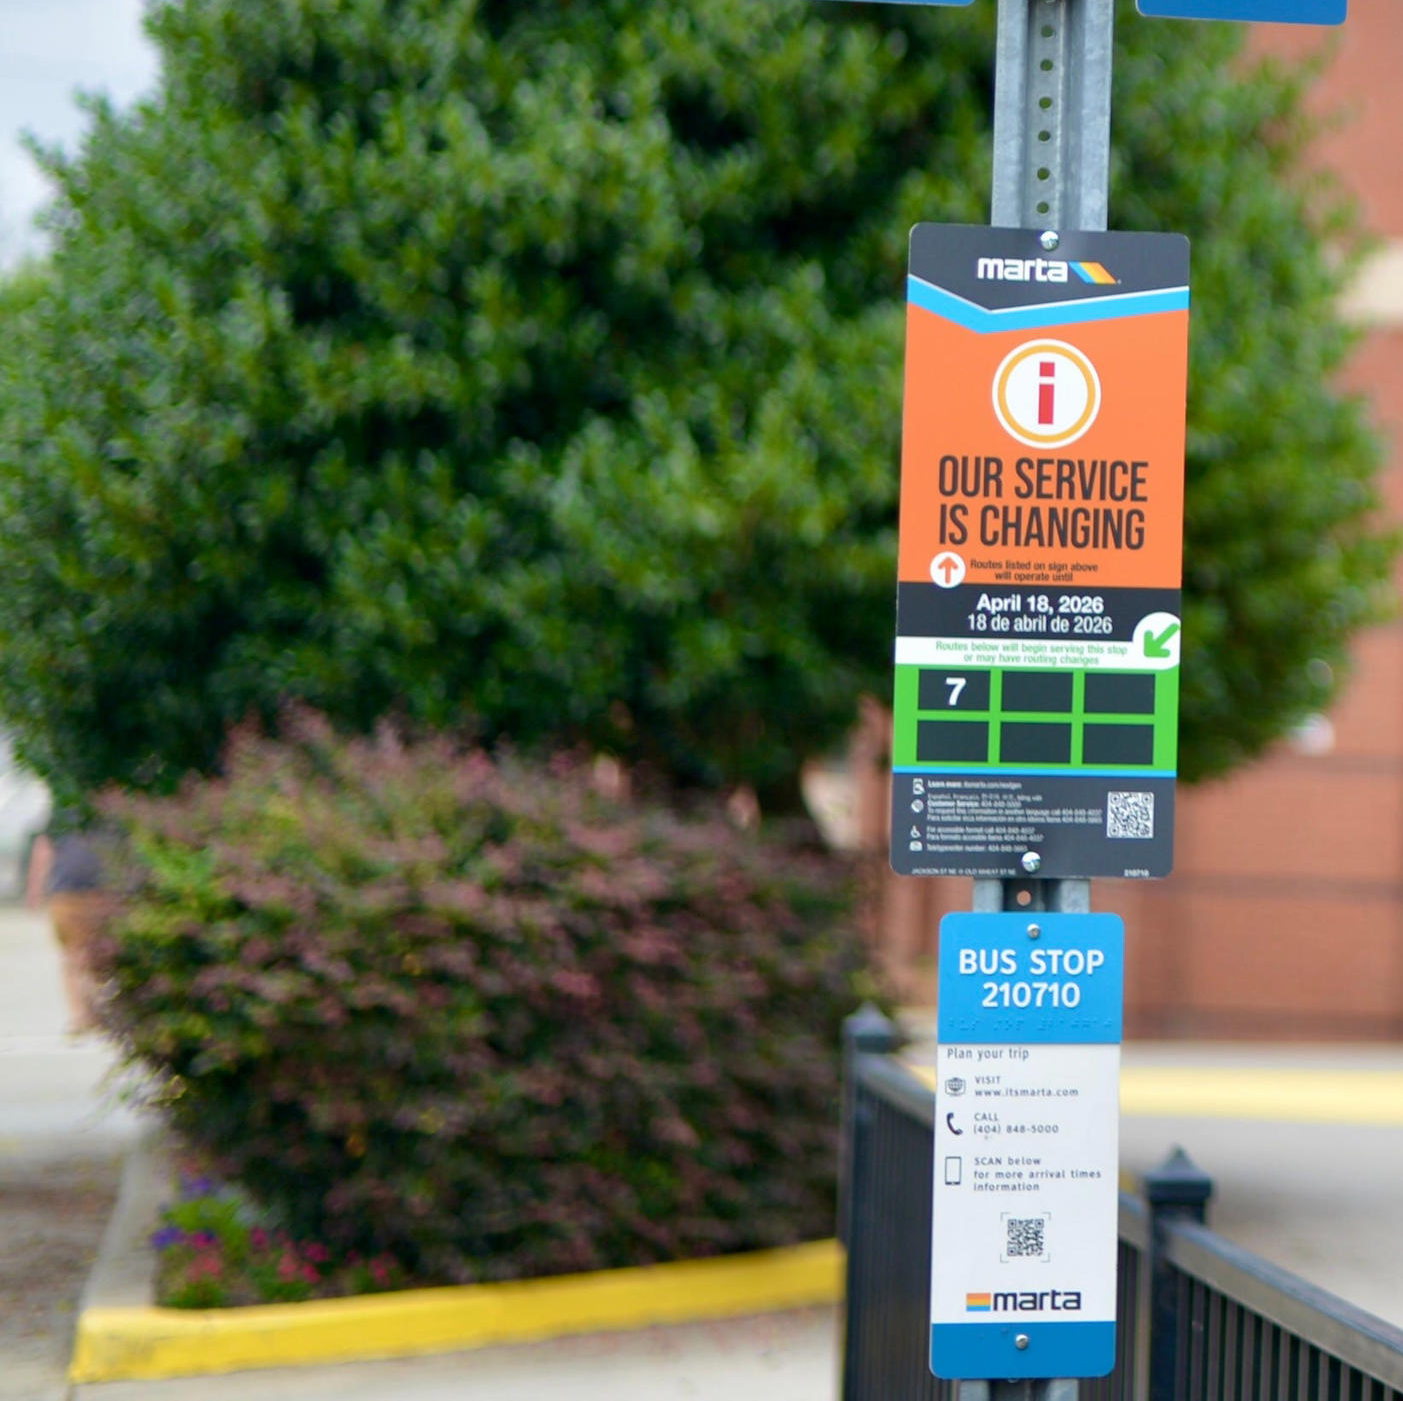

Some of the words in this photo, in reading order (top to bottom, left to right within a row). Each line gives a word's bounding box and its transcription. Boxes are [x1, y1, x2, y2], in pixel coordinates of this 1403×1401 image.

[977, 257, 1069, 283] marta
[938, 455, 1003, 498] OUR
[1014, 457, 1149, 502] SERVICE
[939, 503, 968, 545] IS
[980, 505, 1145, 550] CHANGING
[970, 560, 1002, 570] Routes
[1005, 560, 1031, 570] listed
[1034, 563, 1046, 571] on
[1048, 562, 1068, 573] sign
[1071, 562, 1098, 572] above
[995, 571, 1011, 580] will
[1014, 573, 1050, 582] operate
[1052, 572, 1073, 581] until
[976, 593, 1021, 615] April
[1027, 594, 1054, 615] 18,
[1058, 595, 1104, 614] 2026
[968, 613, 987, 631] 18
[991, 614, 1010, 632] de
[1014, 614, 1047, 632] abril
[1051, 615, 1070, 633] de
[1073, 616, 1113, 634] 2026
[936, 641, 968, 651] Routes
[971, 641, 998, 652] below
[1002, 642, 1019, 652] will
[1022, 643, 1047, 654] begin
[1050, 644, 1084, 655] serving
[1087, 643, 1104, 653] this
[1107, 644, 1127, 656] stop
[963, 654, 973, 662] or
[976, 654, 996, 664] may
[999, 652, 1021, 662] have
[1024, 653, 1056, 665] routing
[1059, 654, 1099, 665] changes
[945, 677, 966, 706] 7
[959, 949, 1017, 975] BUS
[1030, 949, 1104, 975] STOP
[982, 982, 1081, 1008] 210710
[947, 1048, 972, 1059] Plan
[977, 1049, 1003, 1062] your
[1009, 1048, 1029, 1062] trip
[975, 1076, 1001, 1084] VISIT
[975, 1088, 1079, 1097] www.itsmarta.com
[974, 1112, 999, 1121] CALL
[973, 1125, 1001, 1135] (404)
[1006, 1125, 1059, 1134] 848-5000
[974, 1157, 1002, 1166] SCAN
[1007, 1157, 1041, 1166] below
[974, 1170, 989, 1179] for
[995, 1171, 1023, 1179] more
[1028, 1170, 1065, 1179] arrival
[1071, 1170, 1101, 1179] times
[973, 1182, 1040, 1192] information
[993, 1289, 1082, 1311] marta
